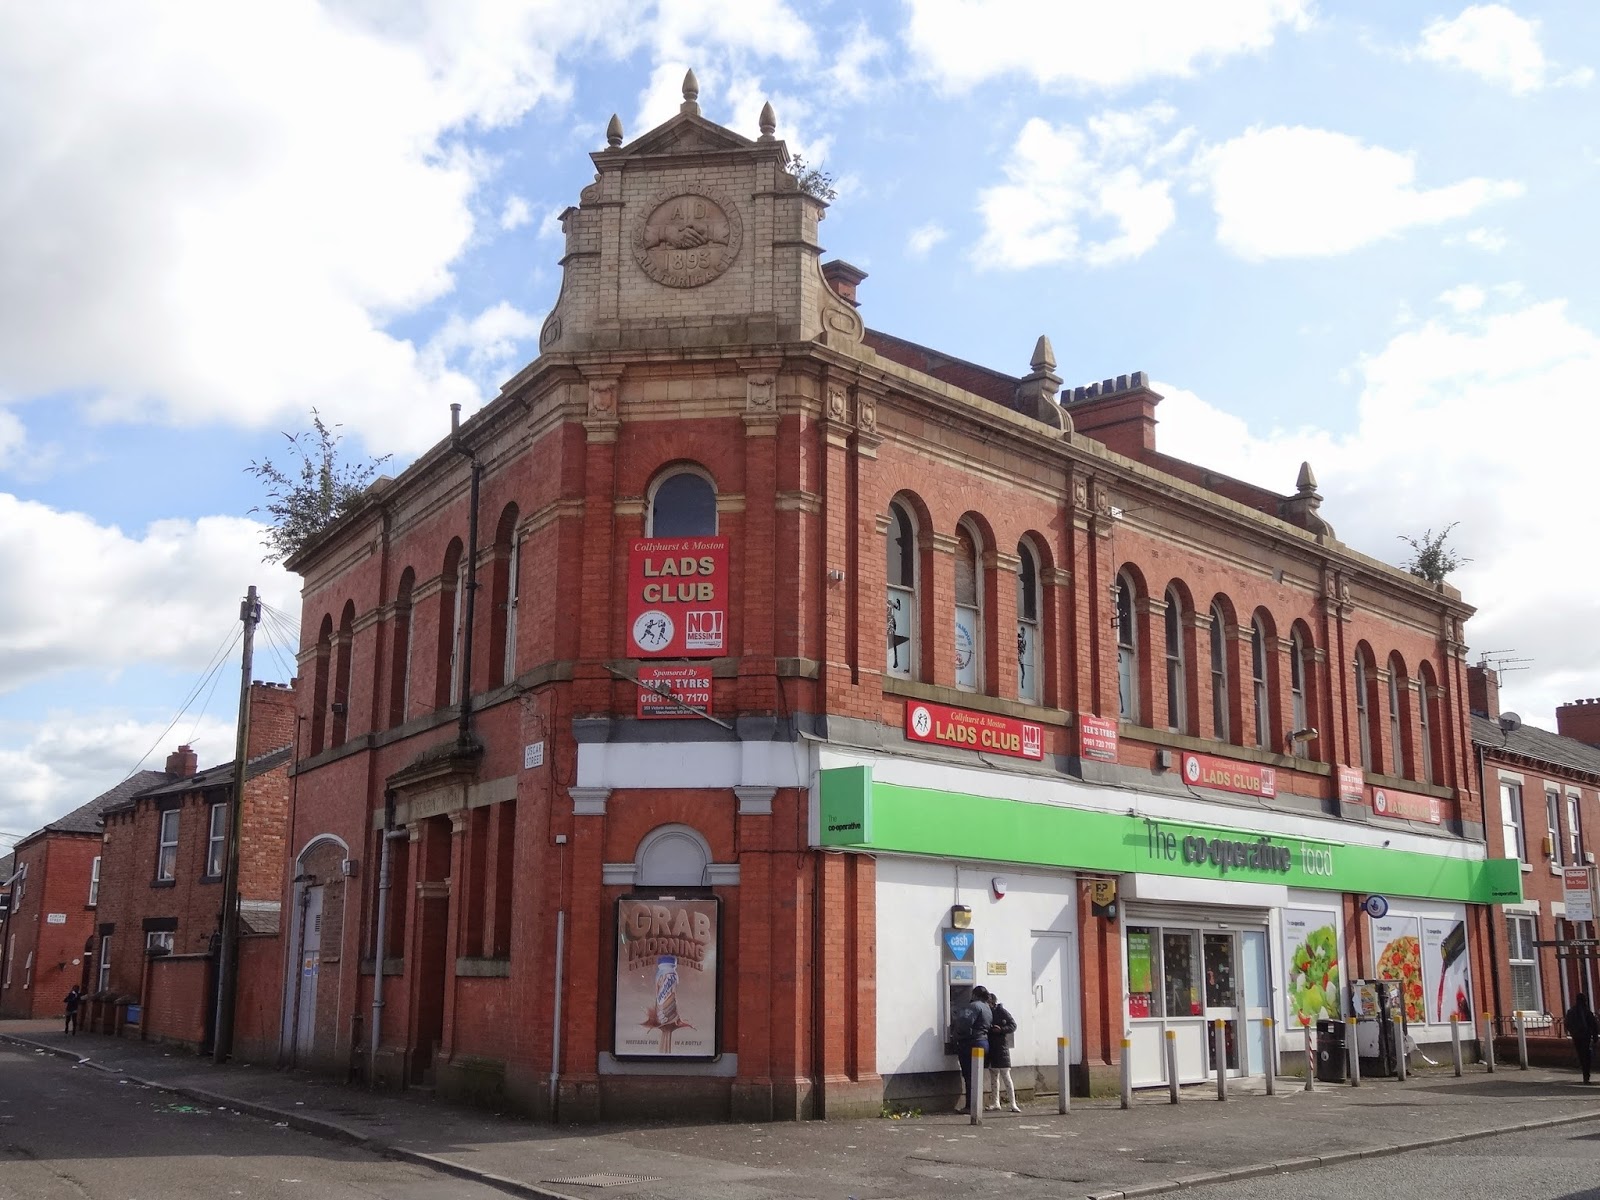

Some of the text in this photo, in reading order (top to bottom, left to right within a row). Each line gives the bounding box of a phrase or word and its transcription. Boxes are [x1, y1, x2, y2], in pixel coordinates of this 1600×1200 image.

[685, 183, 714, 196] FOR
[660, 273, 688, 288] FOR
[634, 541, 724, 552] Collyhurst & Moston
[644, 556, 715, 577] LADS
[643, 583, 715, 602] CLUB
[688, 612, 722, 635] NO!
[653, 669, 697, 677] Sponsored By
[675, 678, 710, 688] TYRES
[641, 694, 662, 702] 0161
[686, 693, 709, 702] 7170
[950, 711, 1007, 729] Collyhurst & Moston
[935, 720, 1021, 751] LADS CLUB
[1083, 725, 1116, 739] TEX'S TYRES
[1083, 737, 1095, 746] 0161
[1095, 740, 1105, 748] 720
[526, 744, 542, 757] OSCAR
[526, 754, 542, 767] STREET
[1201, 768, 1260, 791] LADS CLUB
[828, 814, 837, 822] The
[828, 822, 861, 832] co-operative
[1144, 820, 1333, 876] The co-operative food
[630, 904, 711, 942] GRAB
[950, 935, 968, 946] cash
[628, 937, 705, 961] MORNING
